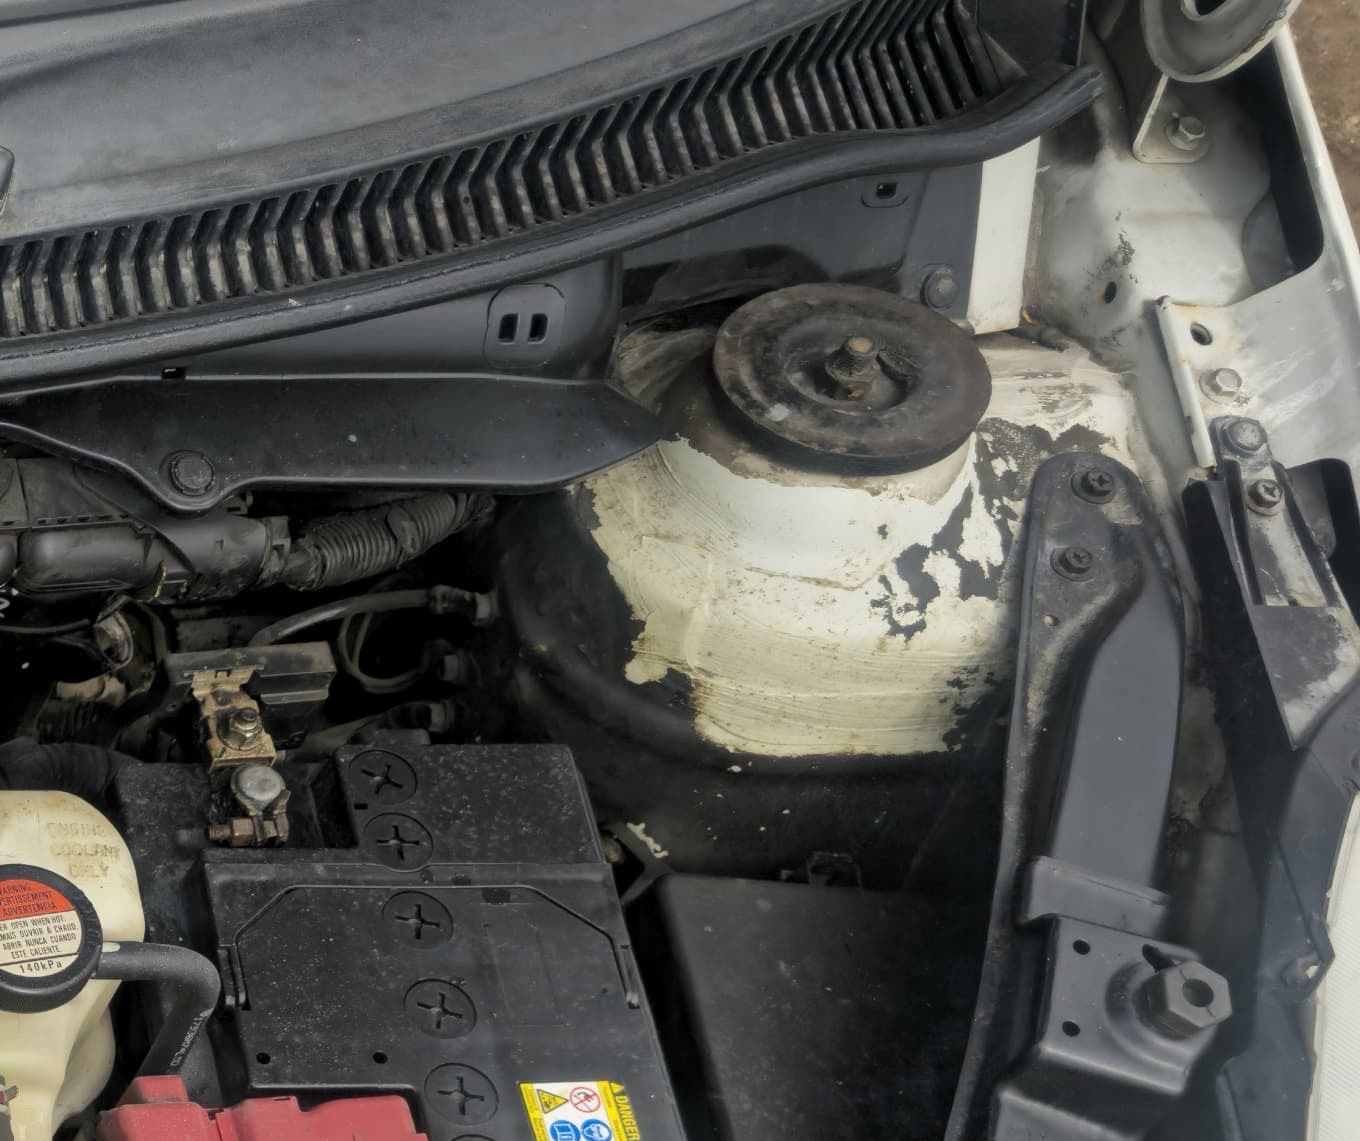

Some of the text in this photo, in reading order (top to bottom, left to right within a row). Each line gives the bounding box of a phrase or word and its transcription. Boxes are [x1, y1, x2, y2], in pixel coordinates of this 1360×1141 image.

[2, 901, 57, 917] ADVERTENCIA
[11, 921, 29, 930] OPEN
[31, 918, 51, 927] WHEN
[20, 928, 44, 938] OUVRIR
[3, 940, 22, 951] ABRIR
[26, 937, 48, 947] NUNCA
[50, 933, 76, 944] CUANDO
[11, 950, 27, 960] ESTE
[20, 960, 62, 974] 140kPa
[615, 1095, 641, 1141] DANGER
